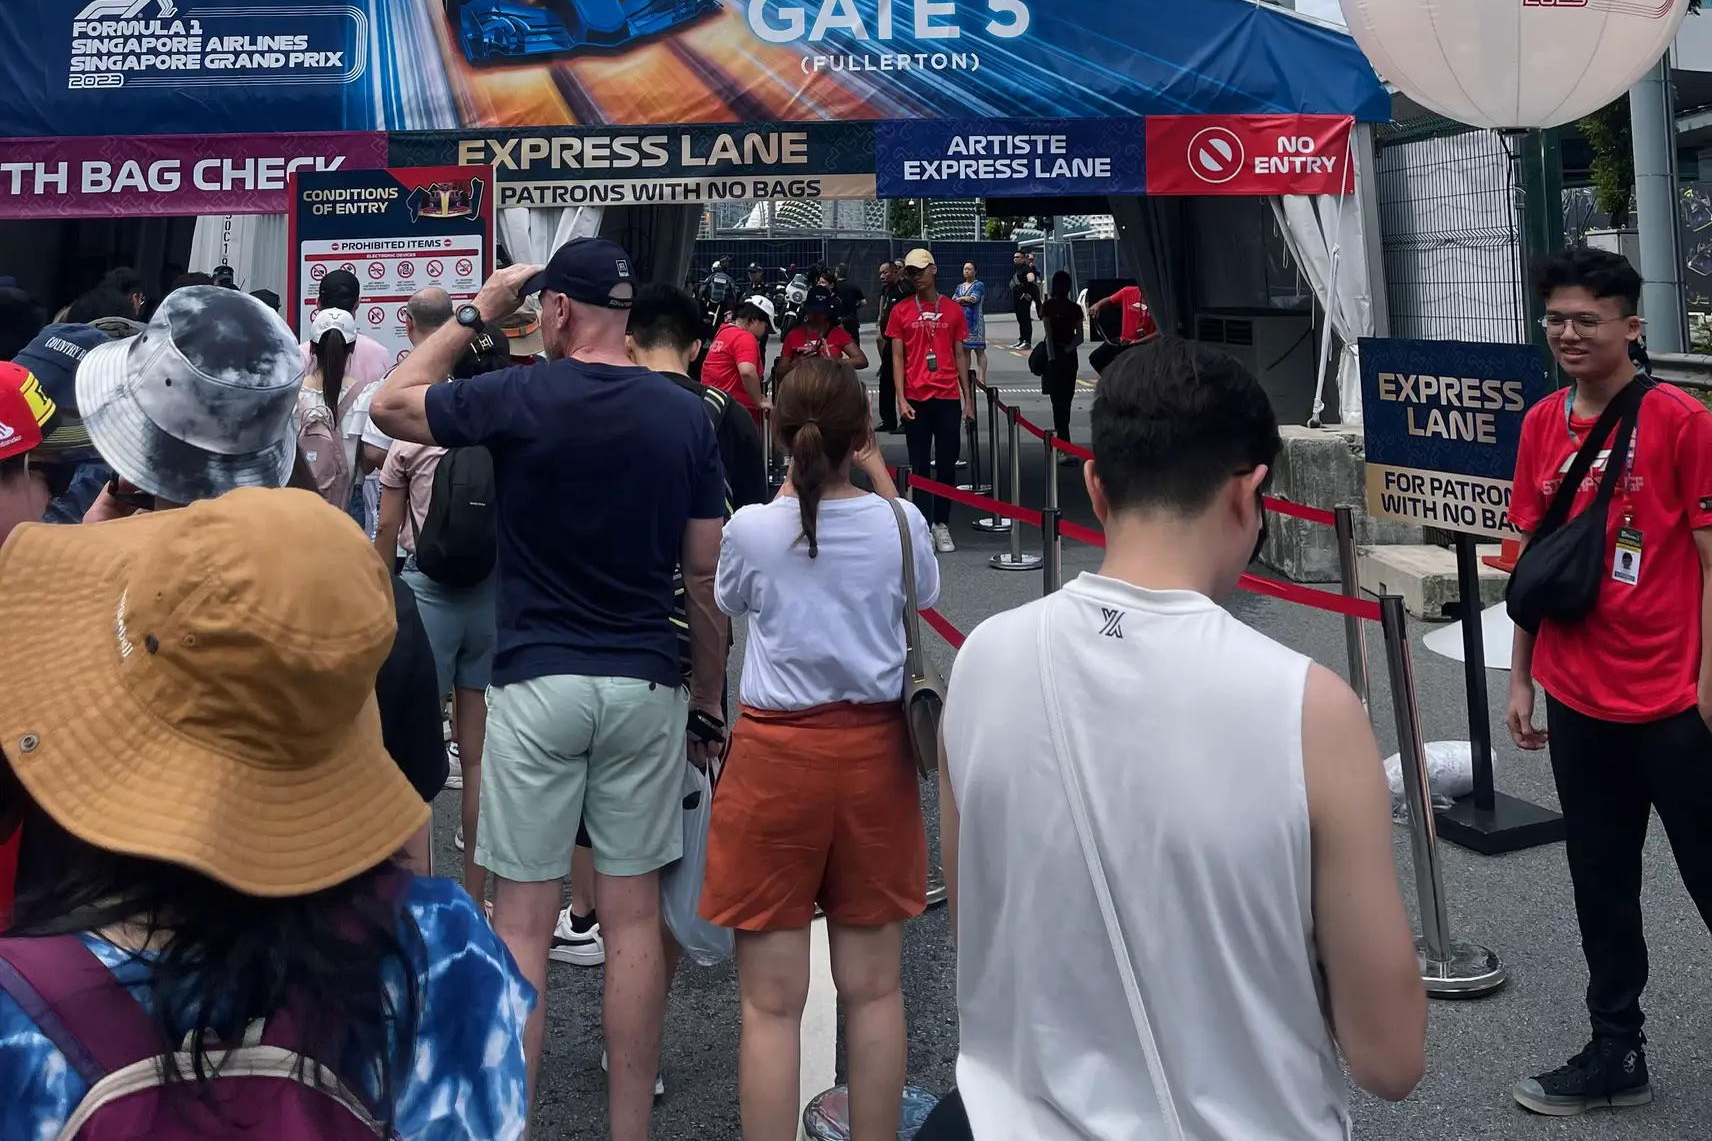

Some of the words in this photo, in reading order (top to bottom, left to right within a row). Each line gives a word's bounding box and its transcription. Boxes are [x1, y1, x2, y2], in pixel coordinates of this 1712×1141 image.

[72, 20, 186, 38] FORMULA
[189, 19, 203, 35] 1
[71, 37, 202, 55] SINGAPORE
[205, 35, 309, 52] AIRLINES
[69, 54, 201, 72] SINGAPORE
[204, 52, 286, 69] GRAND
[288, 51, 344, 68] PRIX
[800, 52, 980, 75] (FULLERTON)
[68, 72, 124, 89] 2023
[457, 135, 669, 171] EXPRESS
[681, 132, 809, 167] LANE
[946, 134, 1067, 156] ARTISTE
[1277, 135, 1315, 154] NO
[81, 159, 182, 194] BAG
[904, 158, 1028, 181] EXPRESS
[1034, 157, 1112, 179] LANE
[1254, 156, 1337, 175] ENTRY
[303, 187, 399, 202] CONDITIONS
[501, 183, 625, 205] PATRONS
[629, 182, 700, 202] WITH
[707, 181, 747, 200] NO
[753, 179, 821, 199] BAGS
[312, 203, 333, 215] OF
[336, 201, 389, 214] ENTRY
[341, 240, 405, 251] PROHIBITED
[407, 239, 441, 249] ITEMS
[44, 336, 82, 358] COUNTRY
[1378, 372, 1525, 412] EXPRESS
[1406, 406, 1497, 444] LANE
[1384, 471, 1426, 495] FOR
[1380, 492, 1438, 520] WITH
[1443, 502, 1477, 526] NO
[1482, 508, 1523, 534] BA
